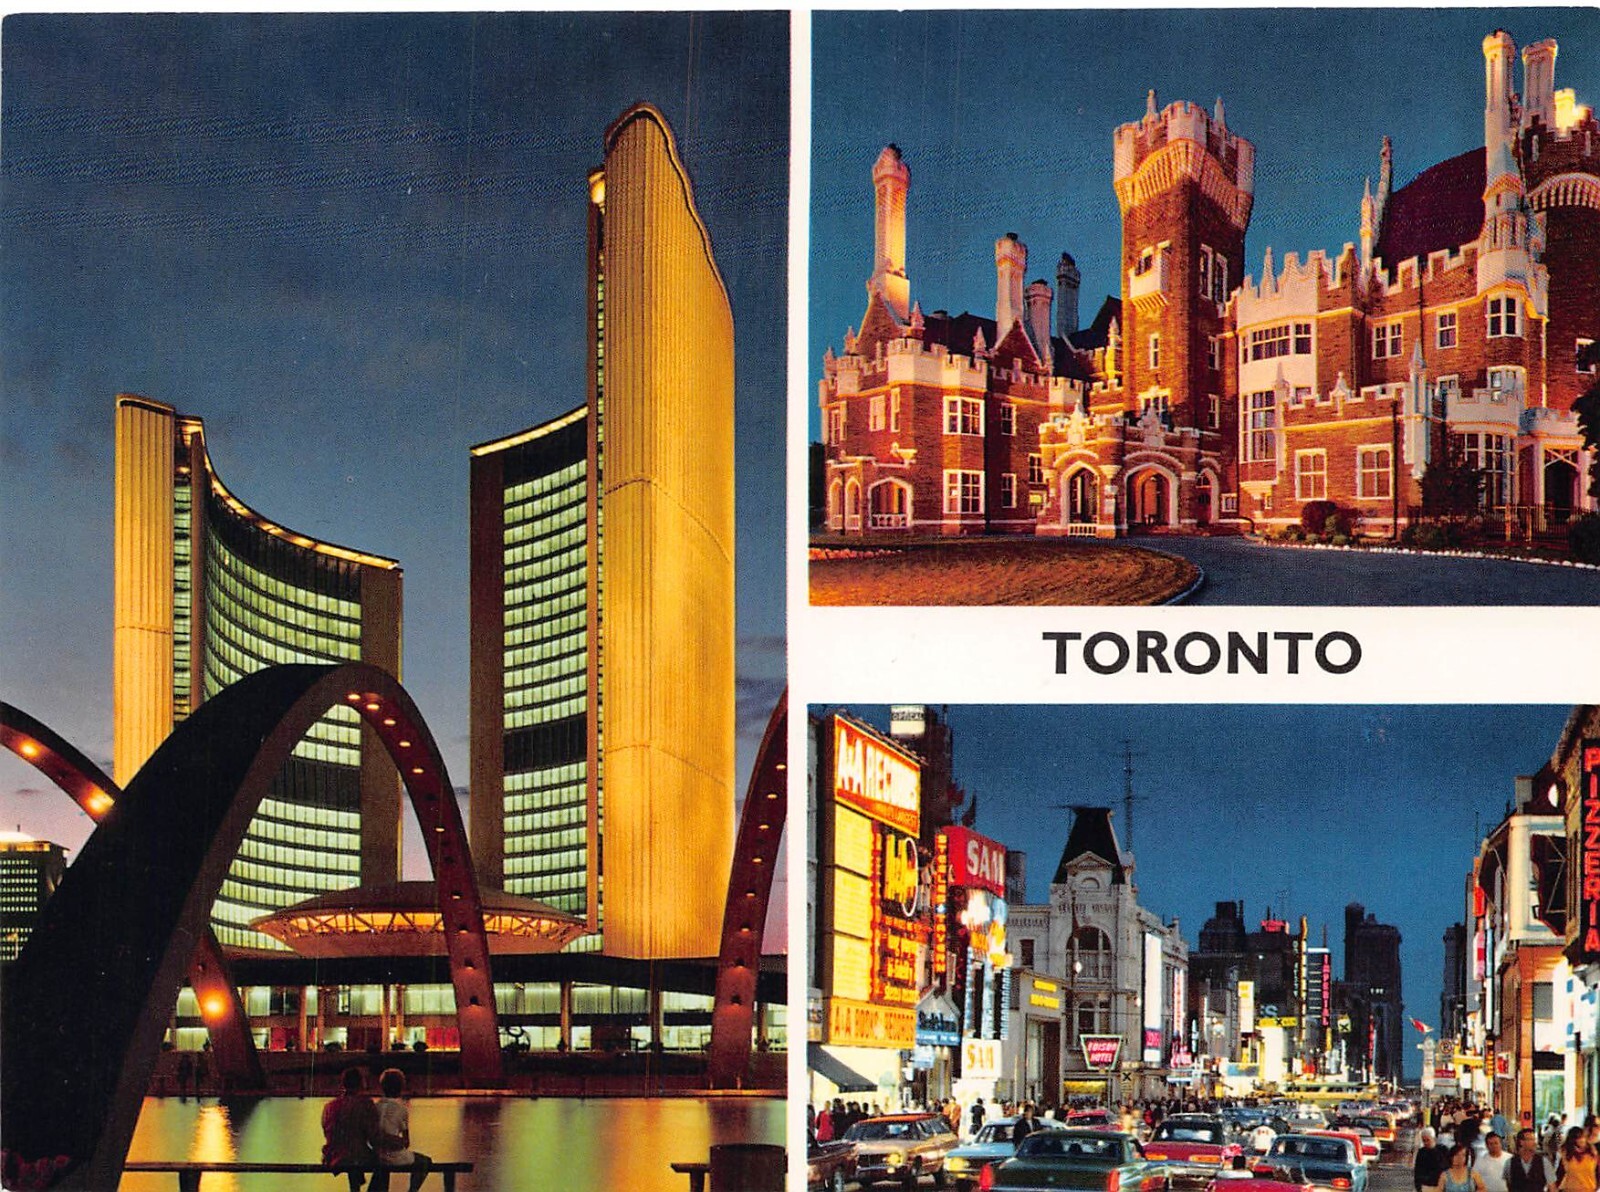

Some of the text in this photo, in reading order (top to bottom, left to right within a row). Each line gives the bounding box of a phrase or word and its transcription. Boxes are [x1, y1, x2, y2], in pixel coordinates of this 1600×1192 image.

[966, 838, 1005, 887] SAM
[1583, 747, 1600, 952] PIZZERIA
[1321, 953, 1331, 1027] IMPERIAL
[1090, 1053, 1113, 1063] HOTEL
